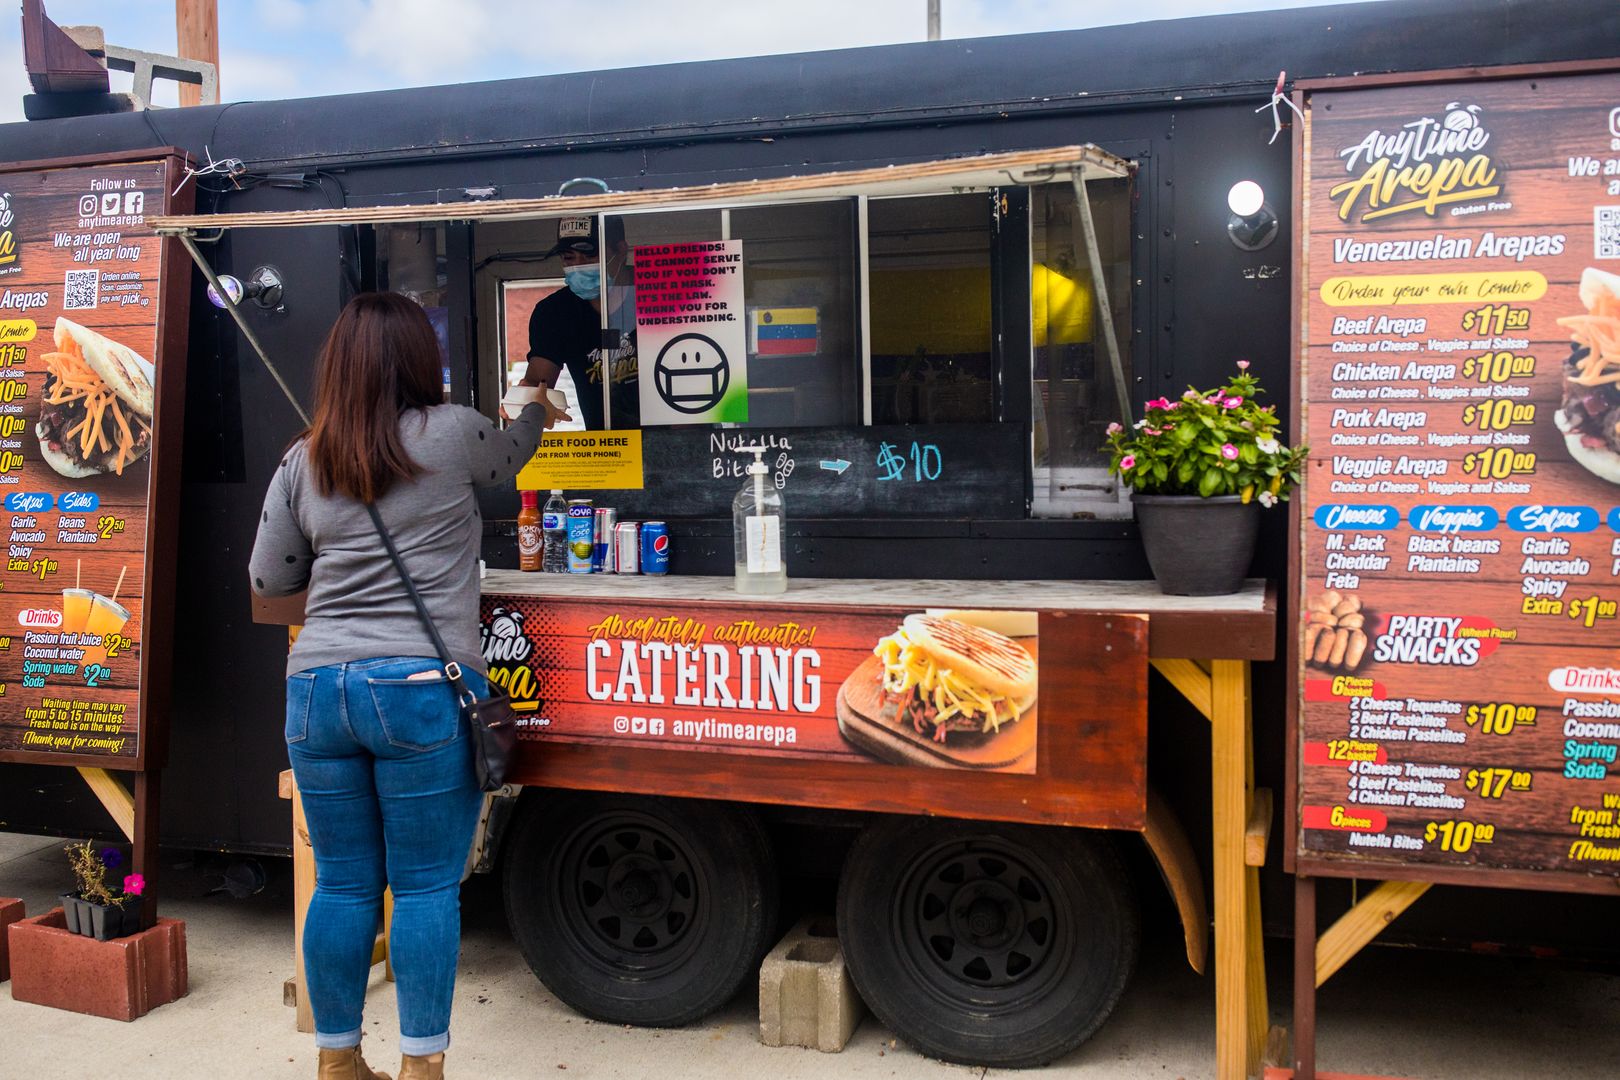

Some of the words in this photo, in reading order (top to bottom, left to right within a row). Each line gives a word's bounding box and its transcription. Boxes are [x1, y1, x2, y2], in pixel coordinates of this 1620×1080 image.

[1340, 117, 1490, 172] Anytime
[1568, 157, 1600, 176] We
[91, 179, 122, 191] Follow
[125, 179, 136, 188] us
[1329, 154, 1497, 221] Arepa
[1451, 204, 1486, 216] Gluten
[1488, 201, 1512, 212] Free
[78, 215, 143, 229] anytimearepa
[54, 233, 72, 247] We
[73, 235, 91, 246] are
[93, 232, 120, 249] open
[636, 246, 670, 256] HELLO
[673, 243, 724, 255] FRIENDS!
[1334, 235, 1472, 263] Venezuelan
[1475, 233, 1566, 262] Arepas
[74, 247, 87, 262] all
[88, 249, 115, 264] year
[116, 245, 140, 262] long
[636, 259, 652, 269] WE
[654, 256, 700, 267] CANNOT
[703, 254, 740, 264] SERVE
[636, 270, 659, 280] YOU
[662, 269, 672, 278] IF
[676, 268, 699, 278] YOU
[702, 266, 737, 276] DON'T
[636, 281, 667, 291] HAVE
[670, 280, 679, 290] A
[681, 279, 716, 289] MASK.
[1393, 285, 1430, 304] your
[1438, 282, 1468, 296] own
[1477, 279, 1532, 298] Combo
[0, 289, 49, 312] Arepas
[637, 292, 658, 303] IT'S
[661, 292, 682, 301] THE
[686, 290, 712, 300] LAW.
[638, 305, 676, 315] THANK
[679, 303, 702, 313] YOU
[705, 301, 728, 311] FOR
[637, 313, 737, 326] UNDERSTANDING.
[1332, 316, 1374, 336] Beef
[1375, 316, 1426, 338] Arepa
[1331, 340, 1367, 353] Choice
[1368, 340, 1380, 352] of
[1380, 340, 1419, 353] Cheese
[1427, 339, 1470, 353] Veggies
[1471, 338, 1492, 350] and
[1493, 337, 1530, 350] Salsas
[1332, 363, 1400, 382] Chicken
[1401, 361, 1456, 384] Arepa
[1331, 408, 1374, 428] Pork
[1374, 408, 1427, 430] Arepa
[567, 438, 596, 448] FOOD
[599, 437, 629, 447] HERE
[1331, 434, 1367, 446] Choice
[1368, 434, 1380, 445] of
[1427, 433, 1470, 446] Veggies
[1471, 432, 1492, 444] and
[1493, 431, 1530, 444] Salsas
[535, 452, 548, 460] (OR
[571, 451, 592, 459] YOUR
[593, 450, 622, 459] PHONE)
[876, 441, 943, 482] $10
[1332, 456, 1392, 478] Veggie
[1393, 456, 1448, 478] Arepa
[12, 493, 44, 512] Salsas
[63, 491, 93, 509] Sides
[569, 508, 592, 516] GOYA
[1325, 505, 1388, 529] Cheeses
[1419, 506, 1485, 534] Veggies
[1519, 505, 1582, 532] Salsas
[11, 516, 37, 528] Garlic
[58, 516, 86, 528] Beans
[9, 531, 46, 543] Avocado
[57, 531, 98, 543] Plantains
[1325, 534, 1346, 550] M.
[1349, 534, 1387, 551] Jack
[1408, 536, 1452, 553] Black
[1453, 537, 1501, 554] beans
[1521, 537, 1571, 555] Garlic
[9, 545, 32, 560] Spicy
[8, 559, 29, 571] Extra
[1325, 553, 1391, 571] Cheddar
[1408, 555, 1481, 573] Plantains
[1520, 557, 1590, 576] Avocado
[1325, 573, 1360, 589] Feta
[1521, 577, 1567, 598] Spicy
[1522, 597, 1563, 615] Extra
[26, 609, 60, 624] Drinks
[588, 613, 704, 650] Absolutely
[713, 618, 817, 650] authentic!
[1388, 615, 1462, 638] PARTY
[24, 632, 58, 645] Passion
[60, 632, 78, 645] fruit
[78, 635, 102, 647] Juice
[24, 646, 58, 659] Coconut
[60, 648, 85, 660] water
[1373, 634, 1481, 666] SNACKS
[23, 660, 51, 676] Spring
[53, 663, 78, 675] water
[587, 638, 821, 713] CATERING
[22, 675, 45, 688] Soda
[42, 698, 70, 711] Waiting
[73, 700, 90, 710] time
[92, 701, 108, 713] may
[110, 702, 127, 714] vary
[1350, 697, 1360, 710] 2
[1360, 697, 1403, 712] Cheese
[1405, 699, 1462, 715] Tequeños
[25, 708, 47, 720] from
[49, 709, 55, 720] 5
[58, 709, 67, 721] to
[70, 711, 82, 722] 15
[84, 711, 126, 725] minutes.
[530, 717, 550, 726] Free
[1350, 711, 1360, 724] 2
[1361, 711, 1389, 726] Beef
[1389, 712, 1447, 728] Pastelitos
[29, 719, 51, 729] Fresh
[52, 720, 69, 730] food
[70, 721, 78, 731] is
[80, 722, 90, 731] on
[92, 723, 104, 732] the
[105, 724, 121, 735] way
[672, 718, 797, 747] anytimearepa
[1350, 726, 1360, 738] 2
[1360, 726, 1407, 741] Chicken
[1407, 728, 1467, 744] Pastelitos
[54, 737, 71, 749] you
[71, 734, 88, 751] for
[88, 738, 126, 753] coming!
[1563, 740, 1618, 764] Spring
[1563, 760, 1607, 780] Soda
[1406, 794, 1466, 809] Pastelitos
[1571, 805, 1613, 825] from
[1349, 832, 1392, 848] Nutella
[1392, 834, 1424, 850] Bites
